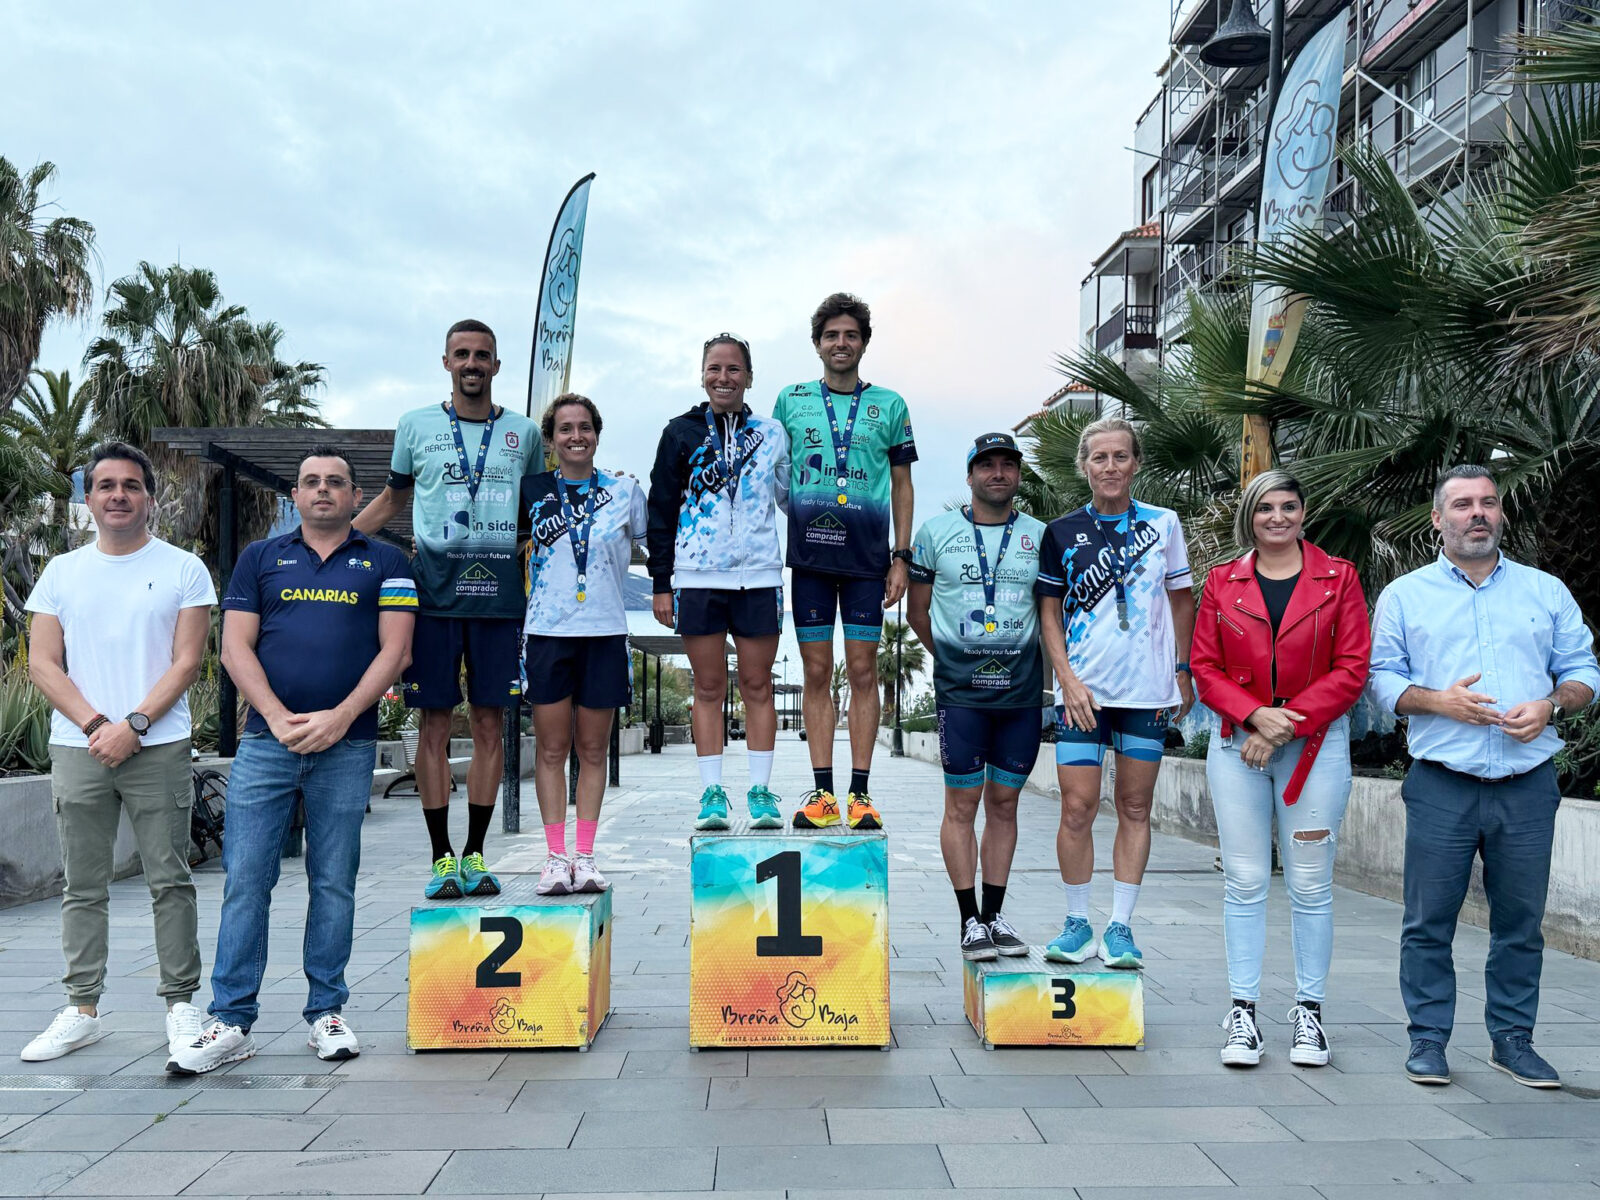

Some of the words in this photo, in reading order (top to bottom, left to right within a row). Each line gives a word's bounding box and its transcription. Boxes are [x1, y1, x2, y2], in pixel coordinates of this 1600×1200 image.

[1264, 196, 1317, 226] Breñ
[540, 320, 573, 343] Breñ
[542, 348, 566, 379] Baj
[425, 443, 457, 453] RÉACTI
[487, 520, 516, 532] side
[806, 531, 847, 542] comprador
[489, 552, 511, 560] future
[280, 588, 359, 604] CANARIAS
[456, 585, 499, 593] comprador
[971, 678, 1011, 687] comprador
[756, 851, 823, 957] 1
[476, 916, 524, 988] 2
[1051, 978, 1077, 1020] 3
[453, 1020, 491, 1033] Breña
[517, 1018, 544, 1036] Baja
[721, 1005, 779, 1026] Breña
[819, 1004, 859, 1032] Baja
